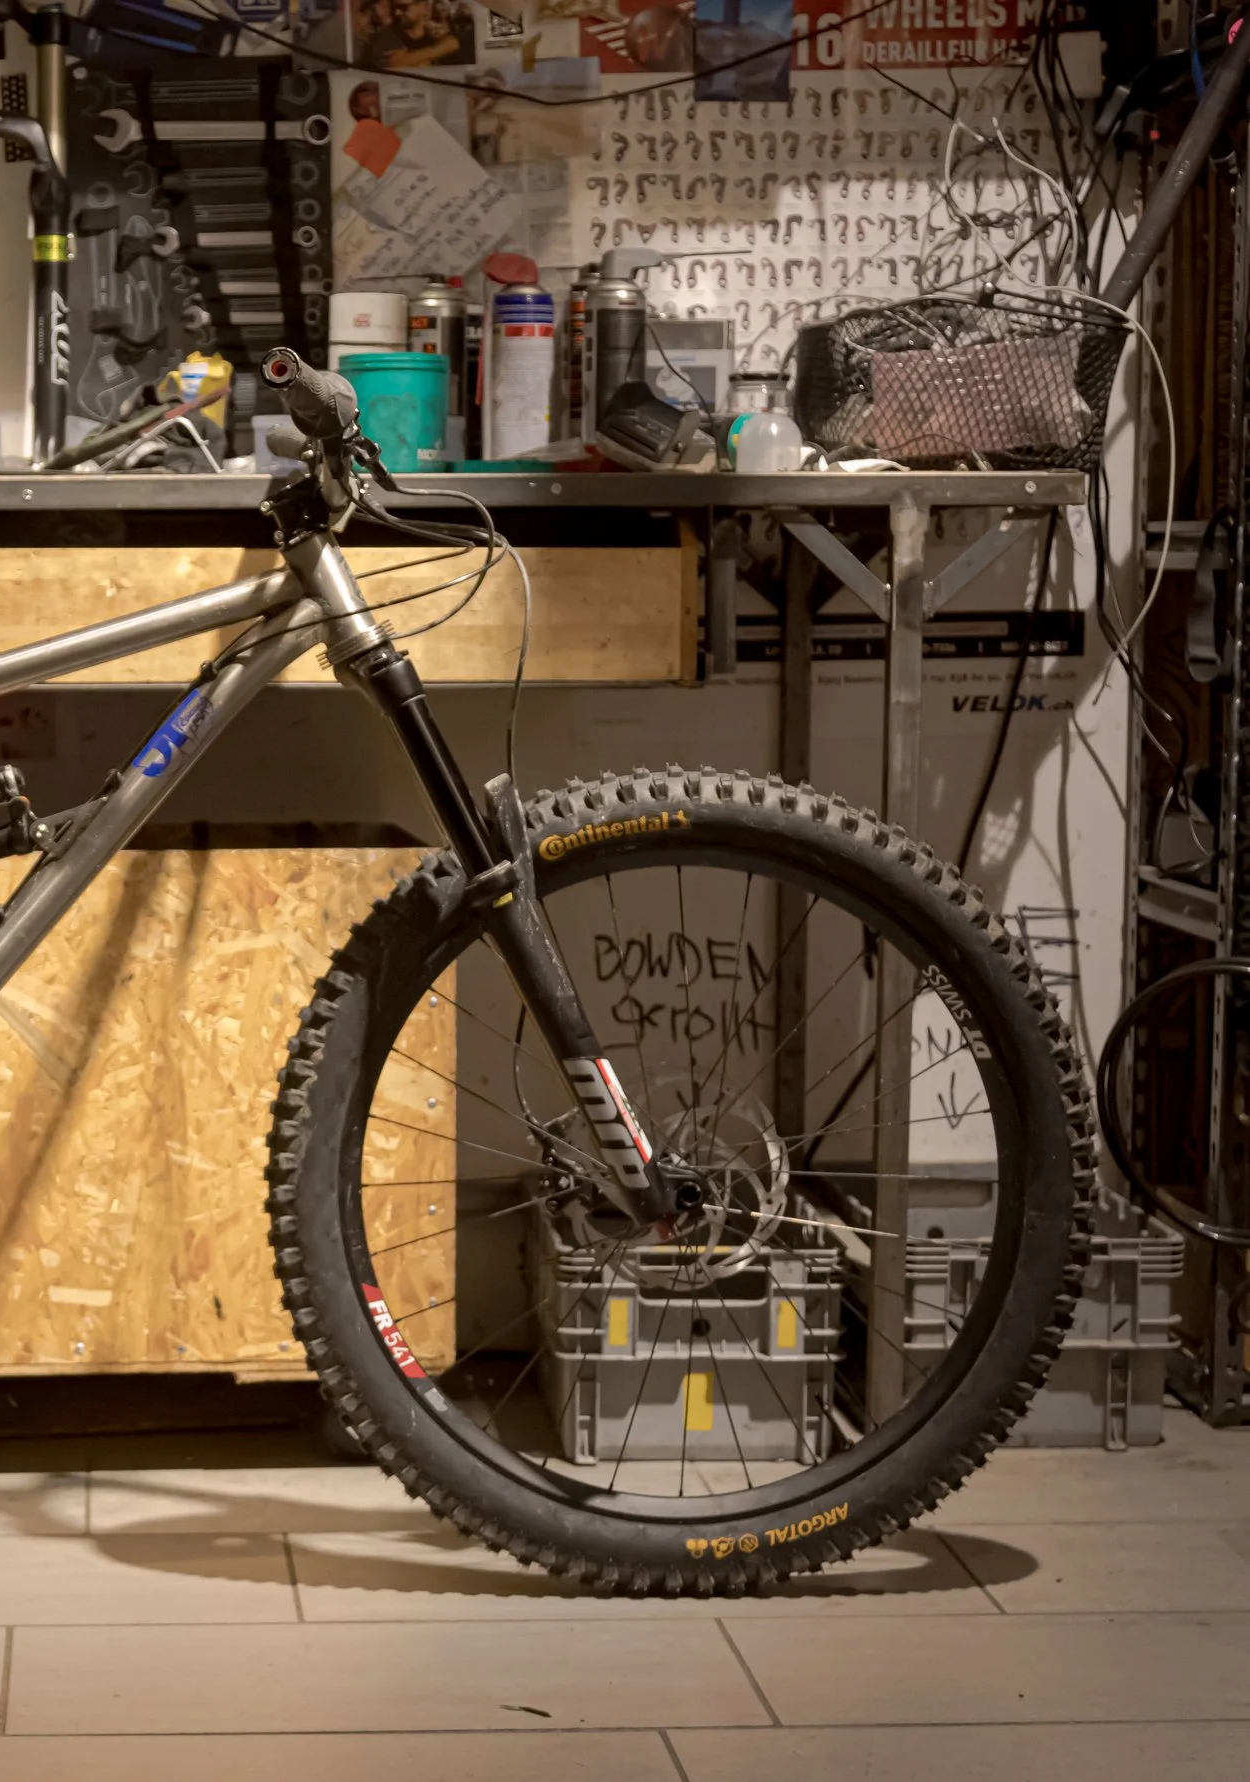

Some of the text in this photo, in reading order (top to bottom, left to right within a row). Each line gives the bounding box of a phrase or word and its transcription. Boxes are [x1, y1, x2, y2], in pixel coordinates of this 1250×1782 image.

[864, 0, 1007, 29] WHEELS
[863, 39, 987, 63] DERAILLEUR
[538, 811, 670, 862] Continental
[594, 932, 772, 995] BOWDEN
[922, 964, 974, 1022] SWISS
[963, 1026, 993, 1061] DT
[367, 1298, 416, 1368] FR 541
[767, 1503, 850, 1545] ARGOTAL
